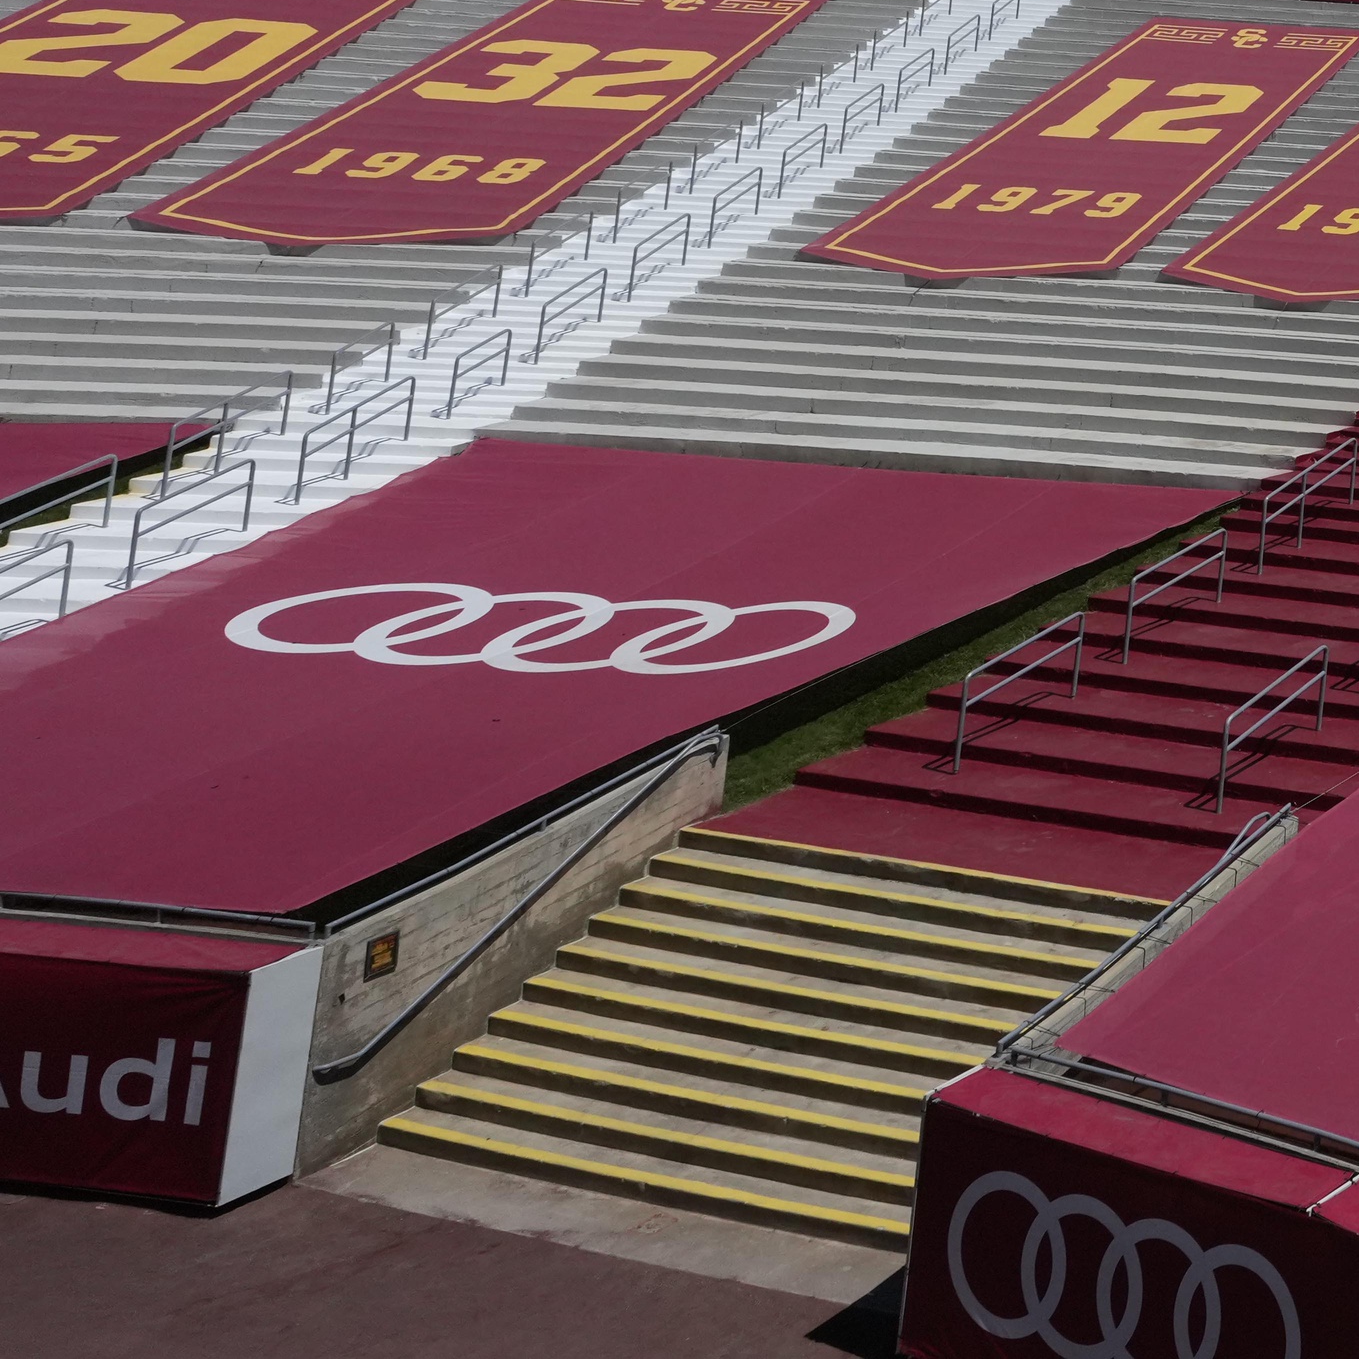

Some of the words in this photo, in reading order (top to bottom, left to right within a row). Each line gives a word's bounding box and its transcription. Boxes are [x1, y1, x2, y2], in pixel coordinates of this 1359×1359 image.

[0, 9, 317, 85] 20
[414, 40, 717, 111] 32
[1038, 77, 1264, 144] 12
[296, 148, 545, 184] 1968
[932, 183, 1141, 218] 1979
